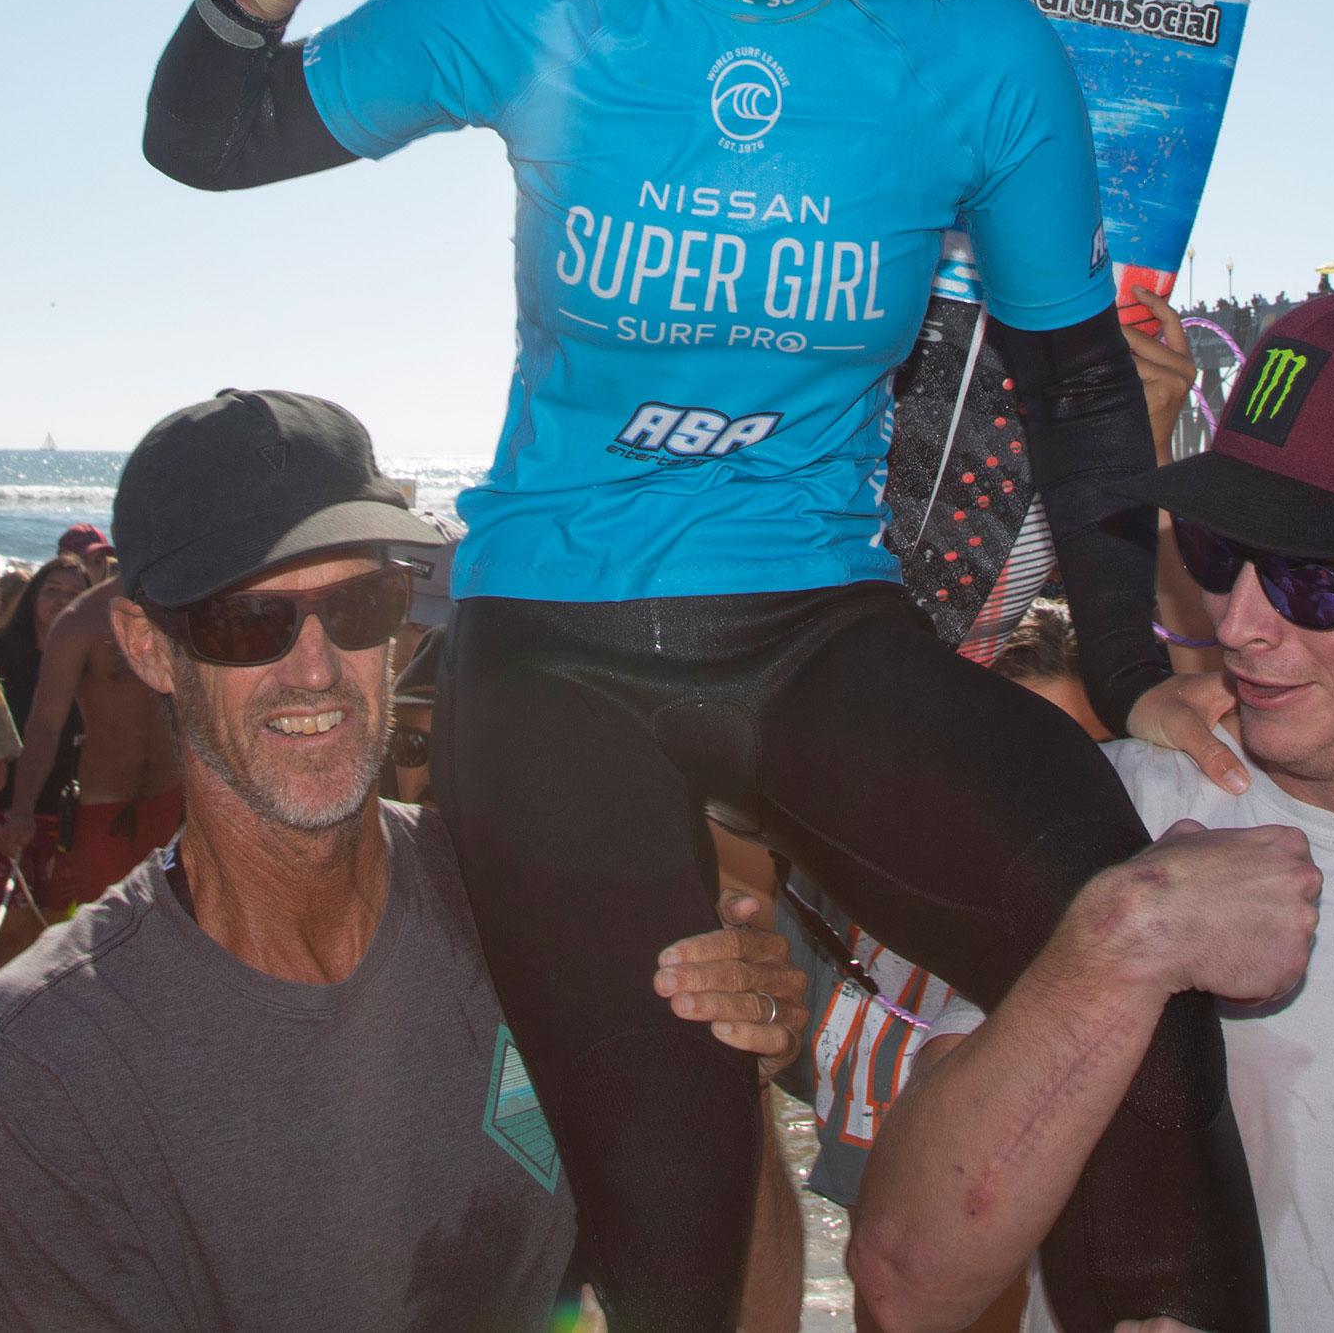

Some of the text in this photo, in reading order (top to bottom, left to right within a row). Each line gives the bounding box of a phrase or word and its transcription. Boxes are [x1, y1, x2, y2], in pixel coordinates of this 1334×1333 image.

[707, 47, 790, 88] WORLD SURF LEAGUE
[738, 140, 765, 153] 1976
[638, 180, 831, 225] NISSAN
[556, 205, 886, 321] SUPER GIRL
[616, 315, 807, 354] SURF PRO
[615, 401, 783, 457] ASA
